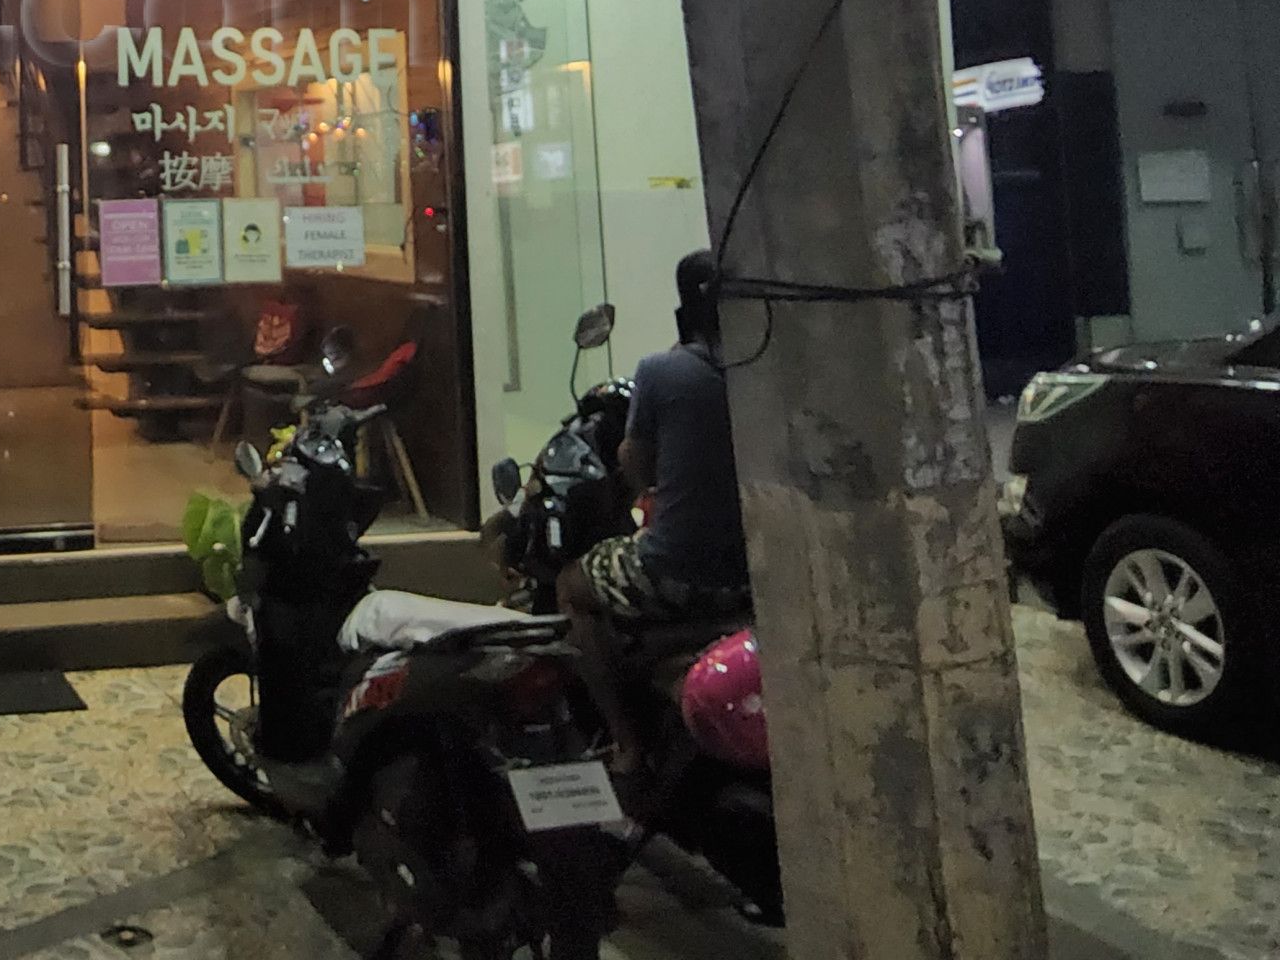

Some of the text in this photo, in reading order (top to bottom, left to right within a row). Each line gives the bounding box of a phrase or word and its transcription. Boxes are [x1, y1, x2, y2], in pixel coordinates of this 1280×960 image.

[117, 27, 399, 88] MASSAGE
[131, 103, 236, 143] 마사지
[158, 150, 234, 191] 按摩
